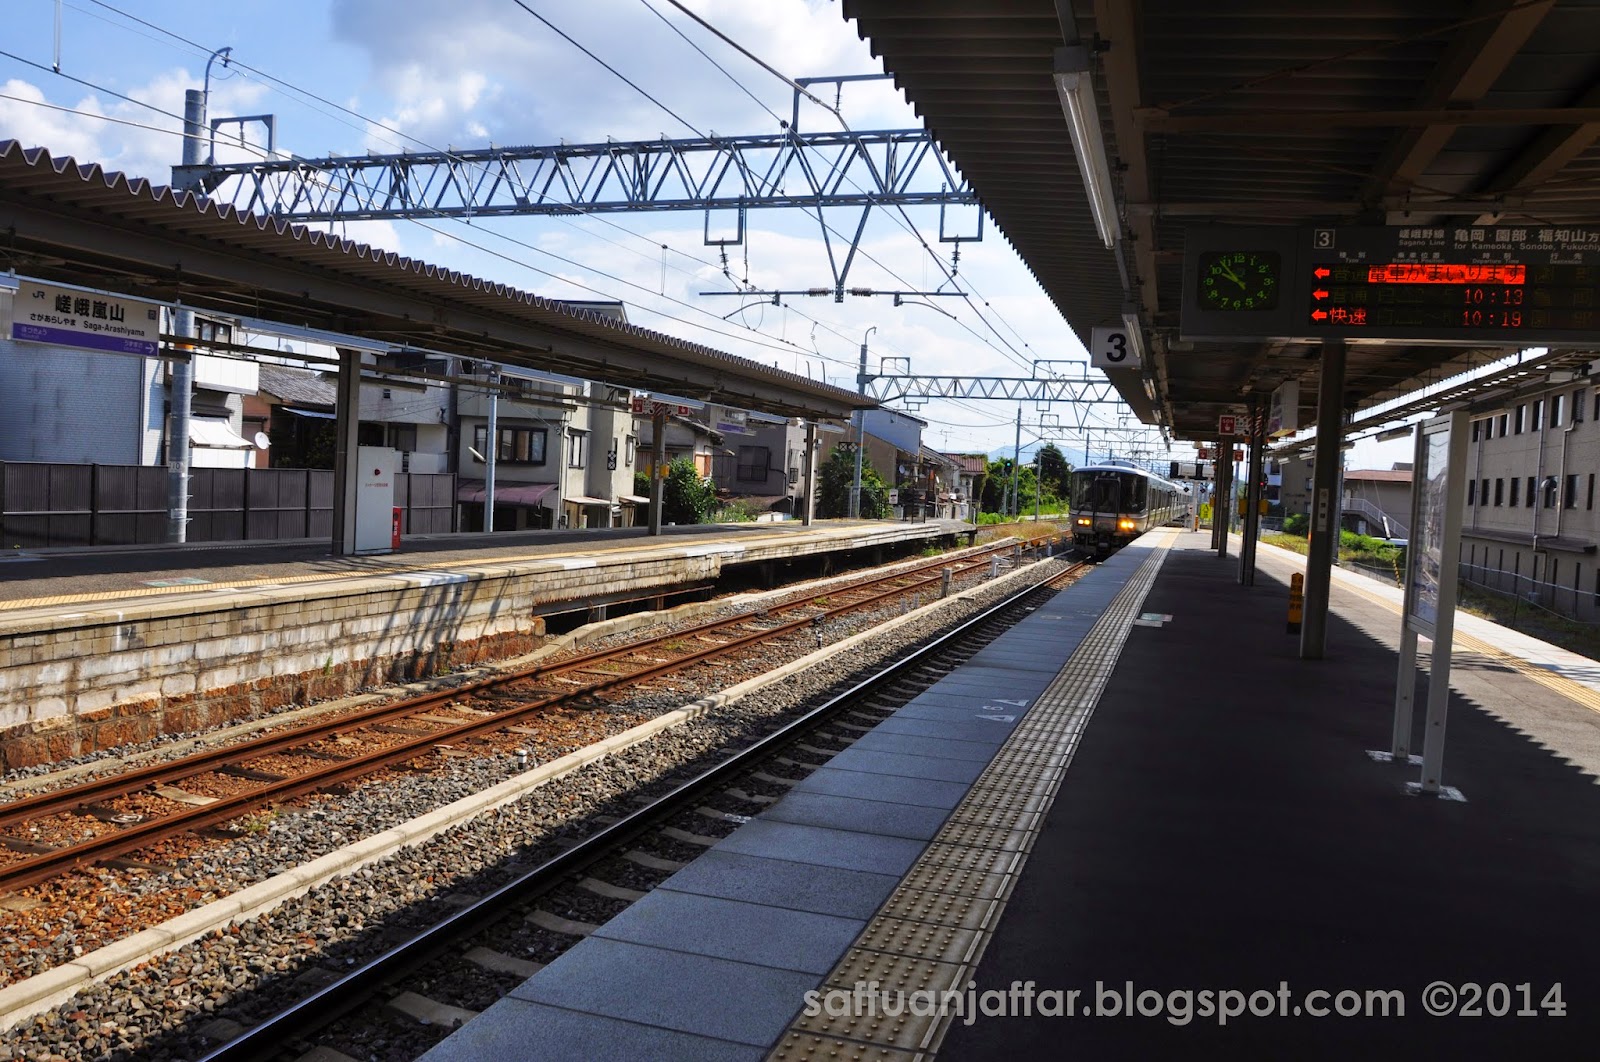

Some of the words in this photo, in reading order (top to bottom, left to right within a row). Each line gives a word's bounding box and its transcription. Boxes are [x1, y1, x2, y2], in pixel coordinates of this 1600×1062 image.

[1319, 231, 1330, 247] 3
[1399, 239, 1426, 247] Sagano
[1233, 255, 1246, 263] 12
[1250, 258, 1255, 266] 1
[1211, 266, 1222, 275] 10
[1258, 265, 1267, 273] 2
[1369, 264, 1525, 283] 電車がまいります
[1207, 277, 1214, 286] 9
[1263, 278, 1271, 286] 3
[32, 290, 45, 300] JR
[1210, 289, 1218, 298] 8
[1256, 290, 1265, 298] 4
[1464, 288, 1524, 305] 10:13
[1221, 297, 1229, 306] 7
[1233, 300, 1241, 308] 6
[1245, 298, 1253, 306] 5
[55, 294, 125, 323] 嵯峨嵐山
[30, 313, 77, 326] さがあらしやま
[1329, 307, 1367, 325] 快速
[1463, 310, 1522, 327] 10:19
[83, 320, 145, 337] Saga-Arashiyama
[1106, 333, 1127, 362] 3
